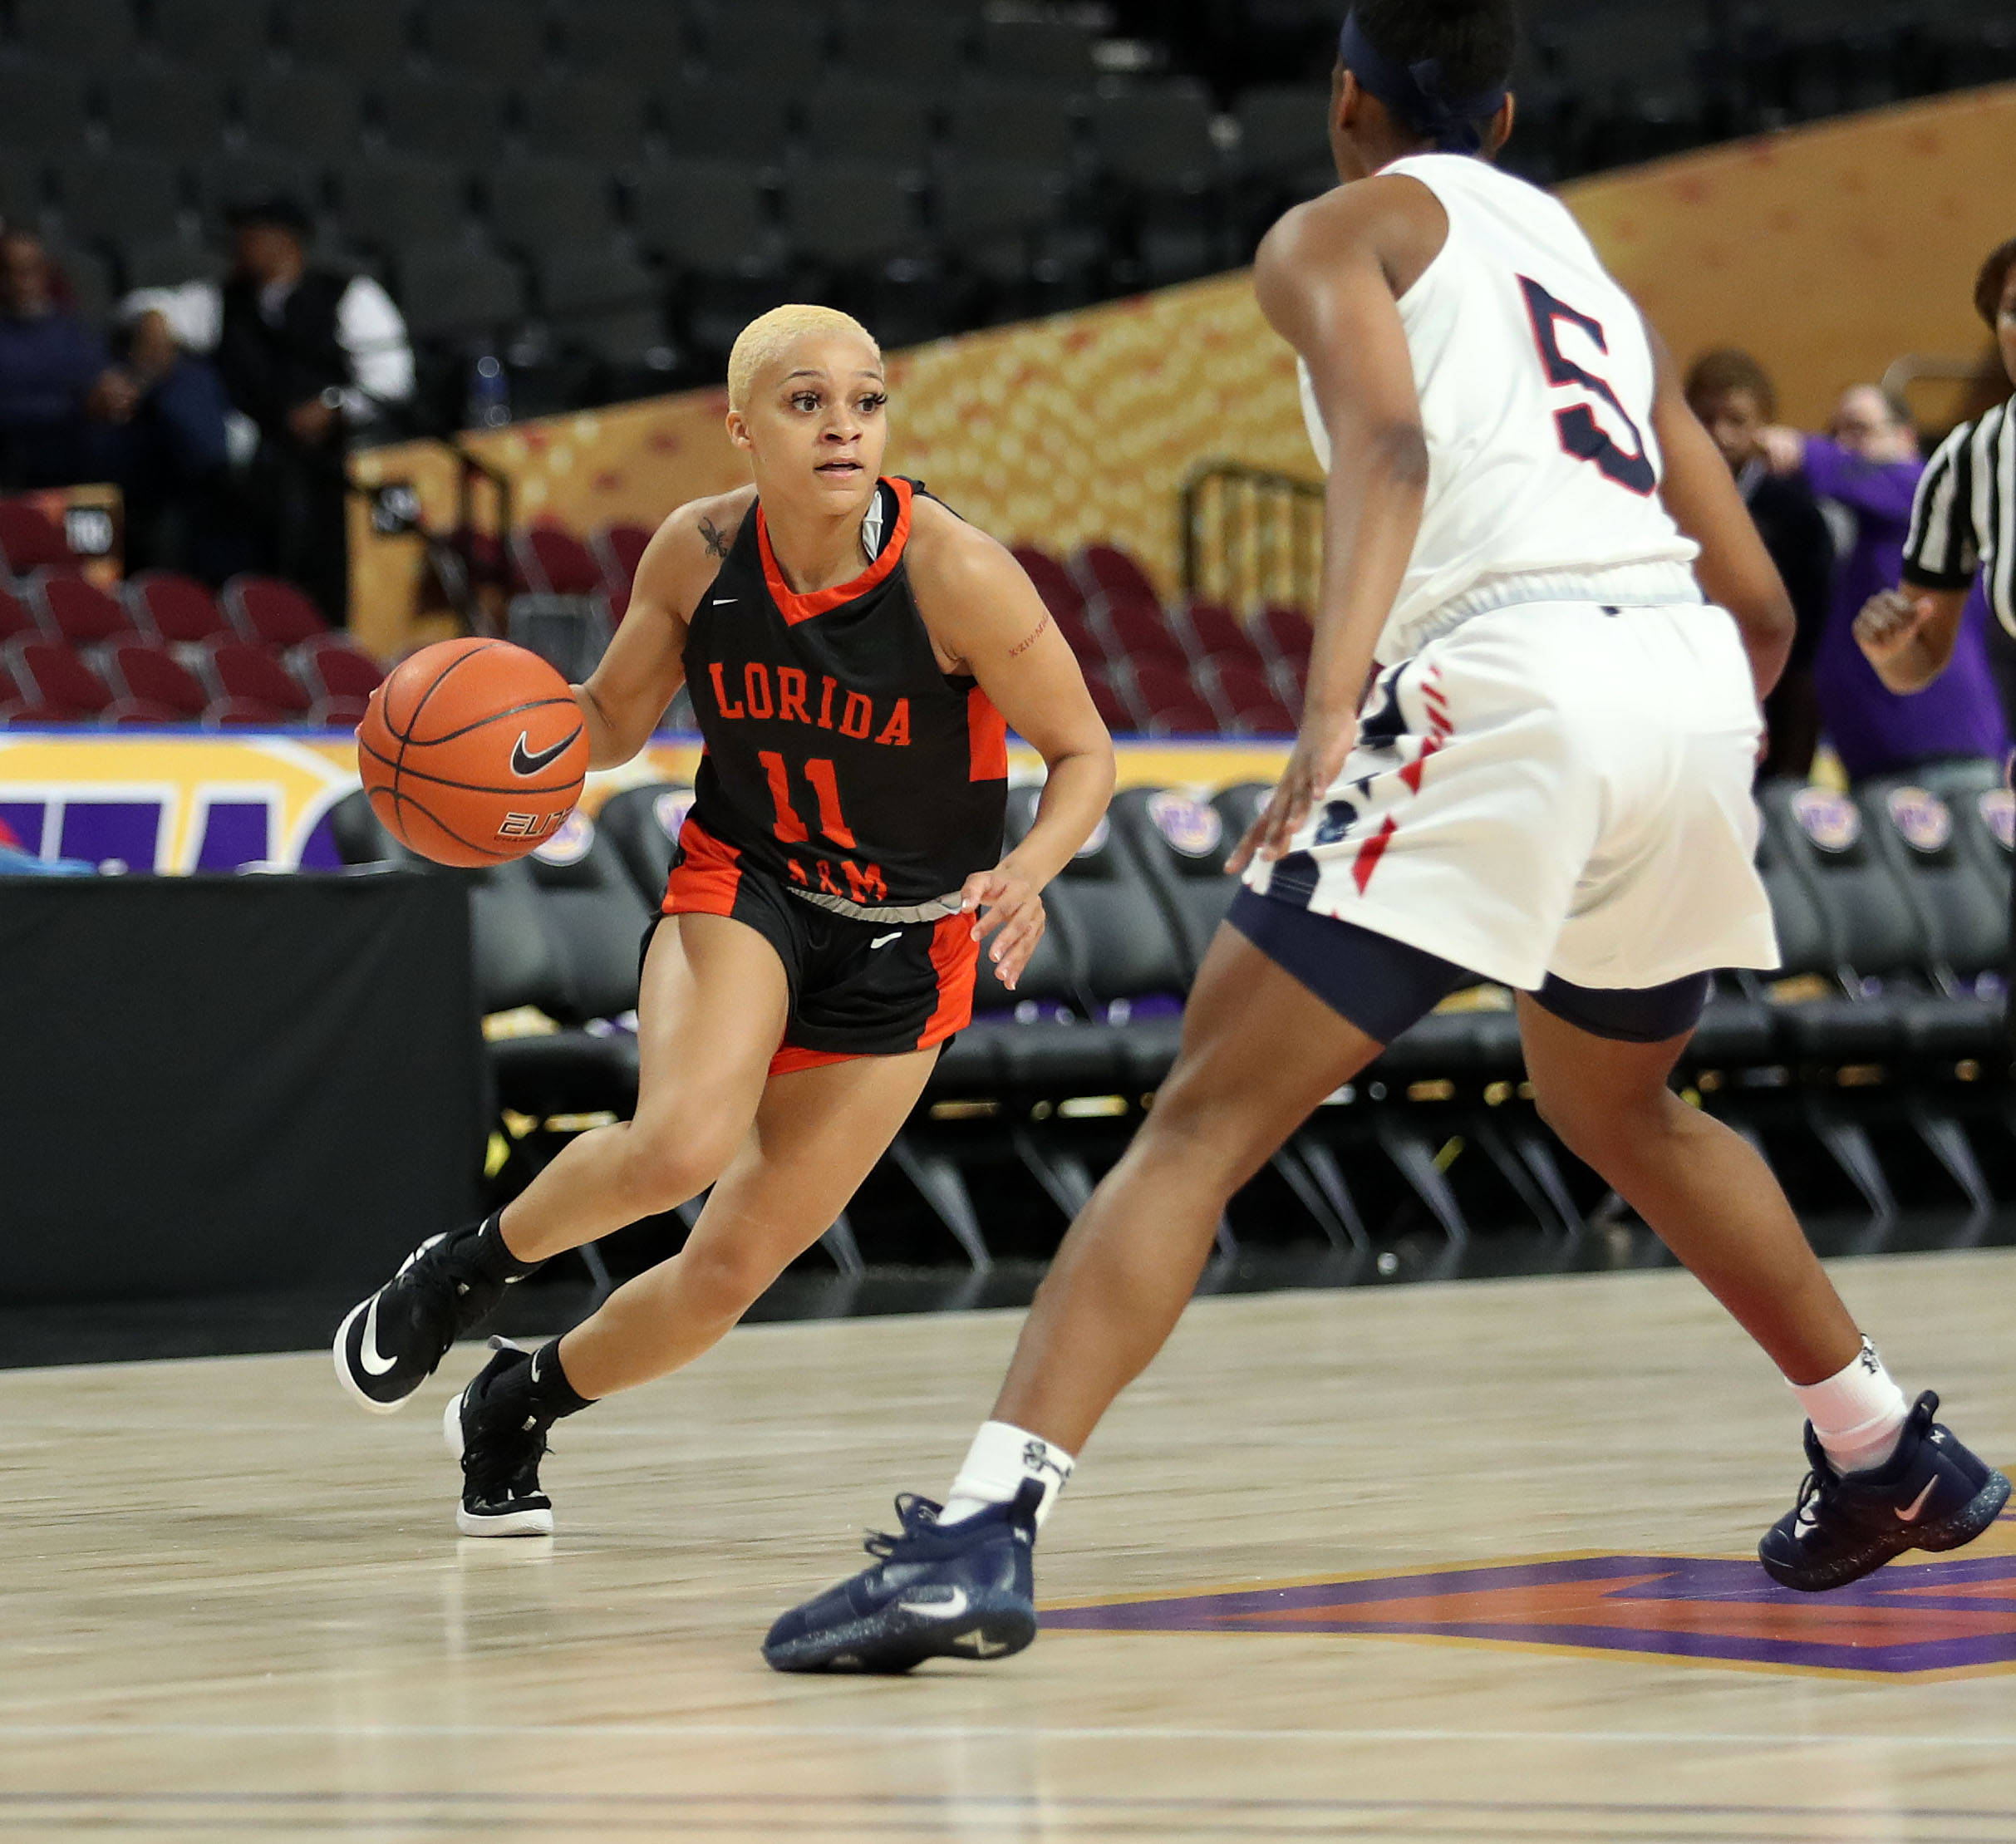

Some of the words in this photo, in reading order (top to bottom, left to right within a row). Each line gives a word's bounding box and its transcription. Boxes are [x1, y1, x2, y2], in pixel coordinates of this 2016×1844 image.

[1514, 273, 1656, 498] 5
[709, 662, 912, 745] LORIDA
[758, 750, 857, 849] 11
